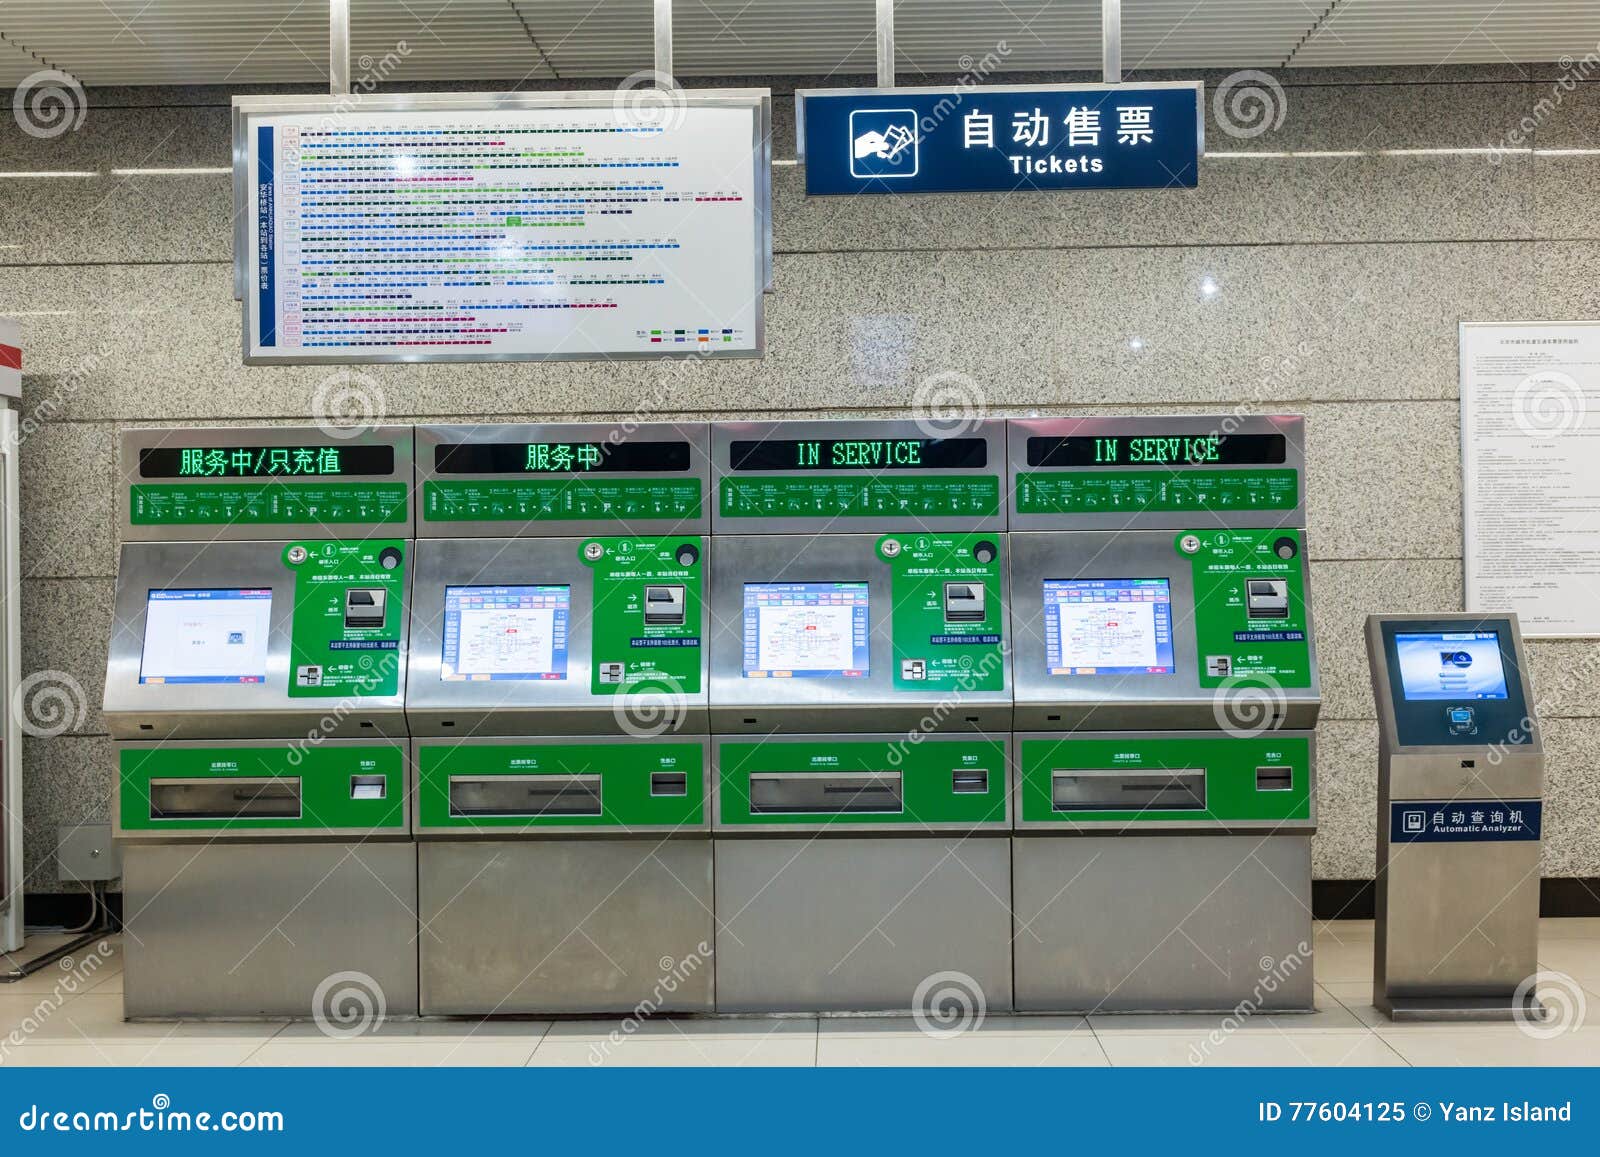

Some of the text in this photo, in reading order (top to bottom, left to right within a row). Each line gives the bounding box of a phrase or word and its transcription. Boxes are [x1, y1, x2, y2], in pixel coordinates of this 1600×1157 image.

[962, 105, 1155, 149] 自动售票
[1009, 155, 1104, 174] Tickets
[525, 443, 600, 472] 服务中
[797, 441, 921, 465] IN SERVICE
[1095, 437, 1220, 462] IN SERVICE
[179, 447, 341, 477] 服务中/只充值
[1432, 810, 1524, 825] 自动查询机
[1433, 824, 1522, 833] Automatic Analyzer
